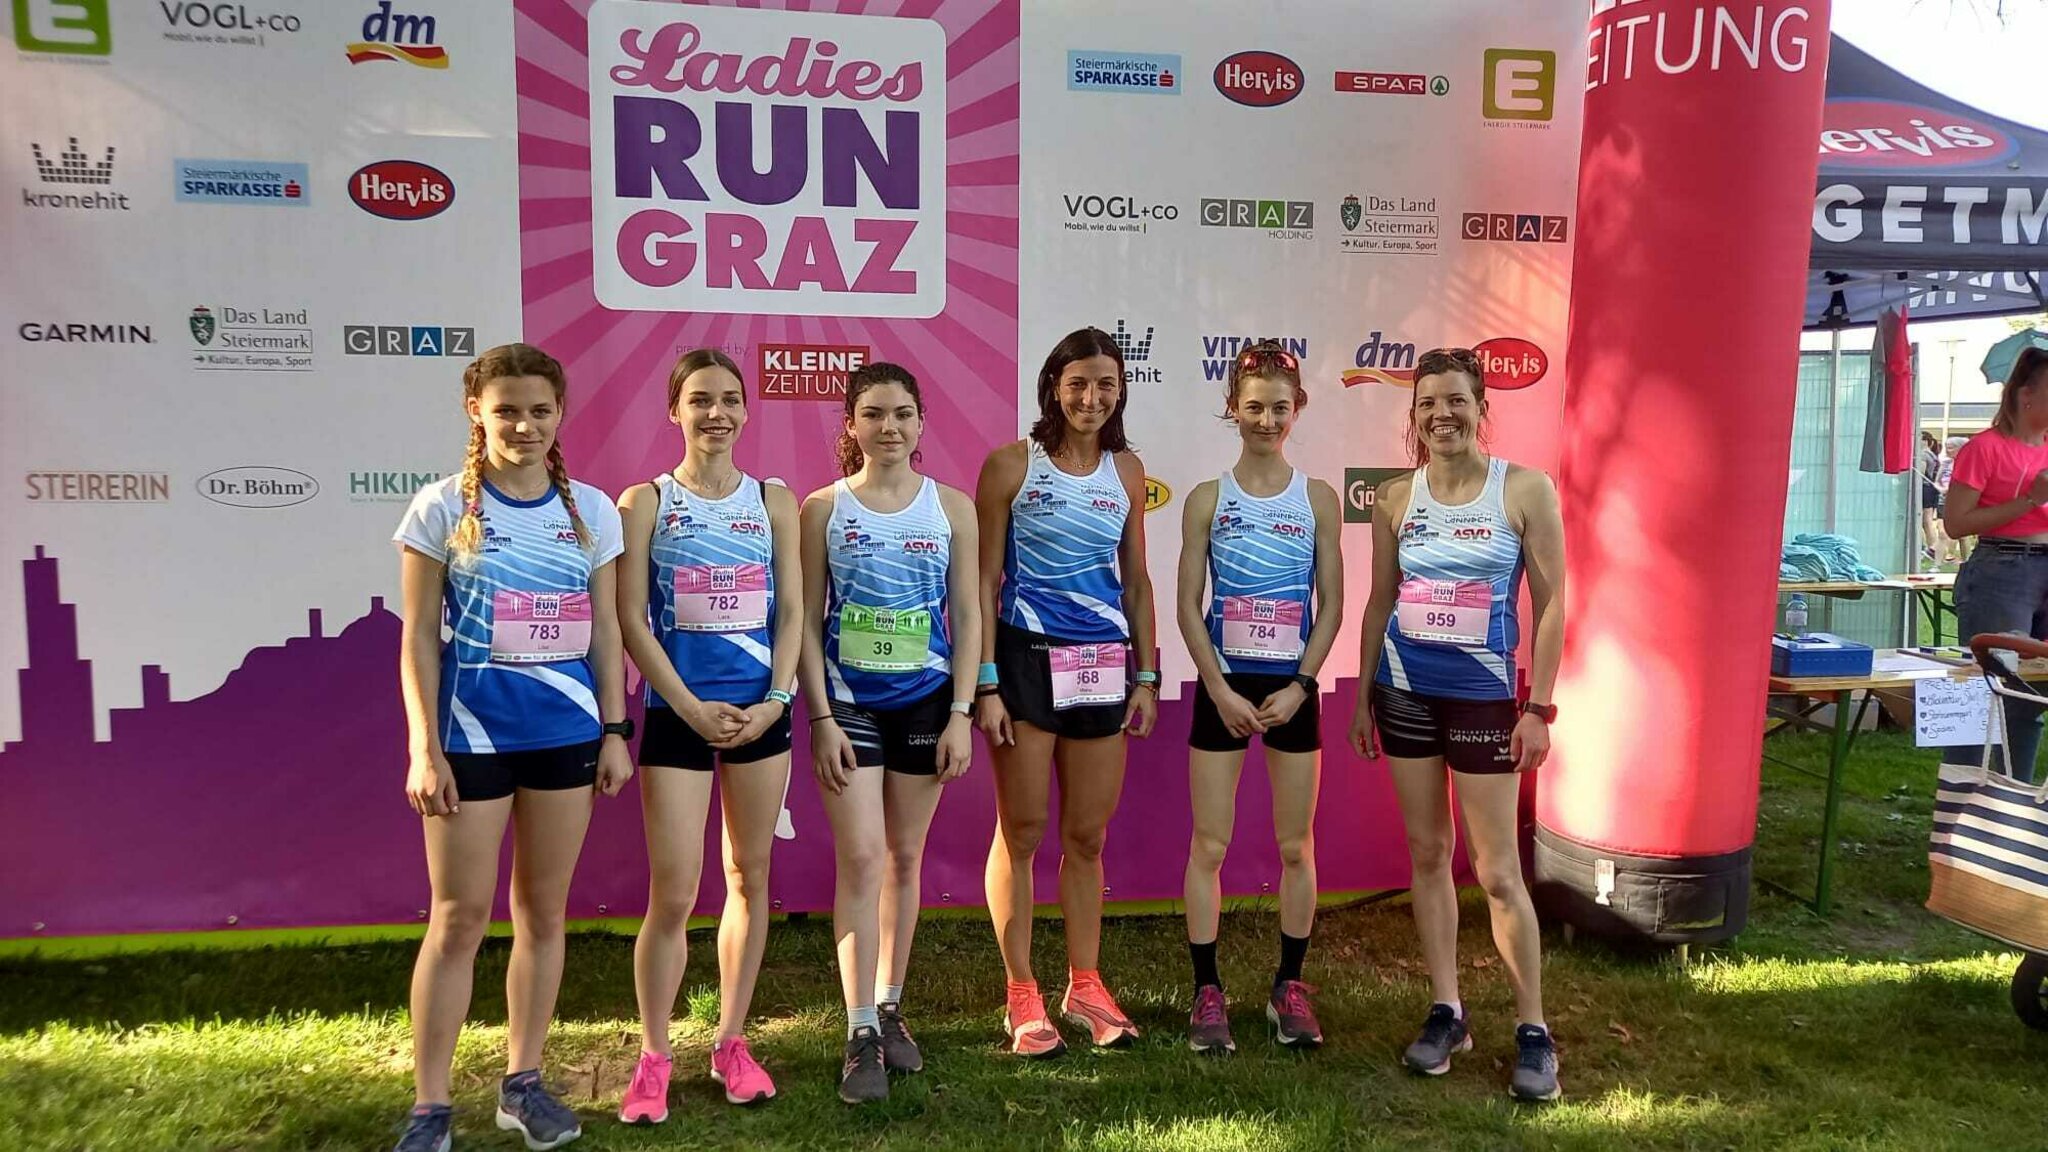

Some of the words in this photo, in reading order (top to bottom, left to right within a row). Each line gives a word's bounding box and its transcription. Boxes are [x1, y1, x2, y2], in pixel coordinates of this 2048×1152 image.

[362, 0, 436, 45] dm
[1585, 6, 1809, 92] EITUNG
[610, 22, 923, 102] Ladies
[1075, 57, 1158, 72] Steiermärkische
[1075, 70, 1158, 87] SPARKASSE
[1224, 63, 1296, 95] Hervis
[1352, 76, 1424, 92] SPAR
[613, 95, 921, 210] RUN
[184, 166, 282, 182] Steiermärkische
[184, 180, 283, 198] SPARKASSE
[360, 173, 446, 207] Hervis
[21, 187, 131, 212] kronehit
[1369, 196, 1395, 212] Das
[1401, 197, 1436, 213] Land
[1203, 202, 1308, 227] GRAZ
[1269, 229, 1313, 241] HOLDING
[1365, 219, 1437, 235] Steiermark
[1465, 216, 1563, 240] GRAZ
[616, 208, 919, 295] GRAZ
[1415, 241, 1437, 251] Sport
[223, 306, 258, 325] Das
[263, 308, 307, 326] Land
[18, 322, 153, 345] GARMIN
[221, 332, 310, 349] Steiermark
[347, 326, 471, 355] GRAZ
[1356, 332, 1416, 369] dm
[286, 356, 312, 368] Sport
[764, 351, 864, 373] KLEINE
[1124, 366, 1162, 383] ehit
[764, 374, 847, 395] ZEITUN
[25, 472, 170, 501] STEIRERIN
[208, 479, 241, 496] Dr.
[350, 472, 441, 494] HIKIM
[1348, 479, 1375, 511] Gö
[712, 574, 734, 583] RUN
[1433, 588, 1454, 596] RUN
[535, 601, 558, 610] RUN
[708, 595, 739, 611] 782
[876, 616, 895, 625] RUN
[1426, 612, 1456, 628] 959
[529, 624, 560, 640] 783
[1249, 624, 1276, 640] 784
[873, 641, 893, 656] 39
